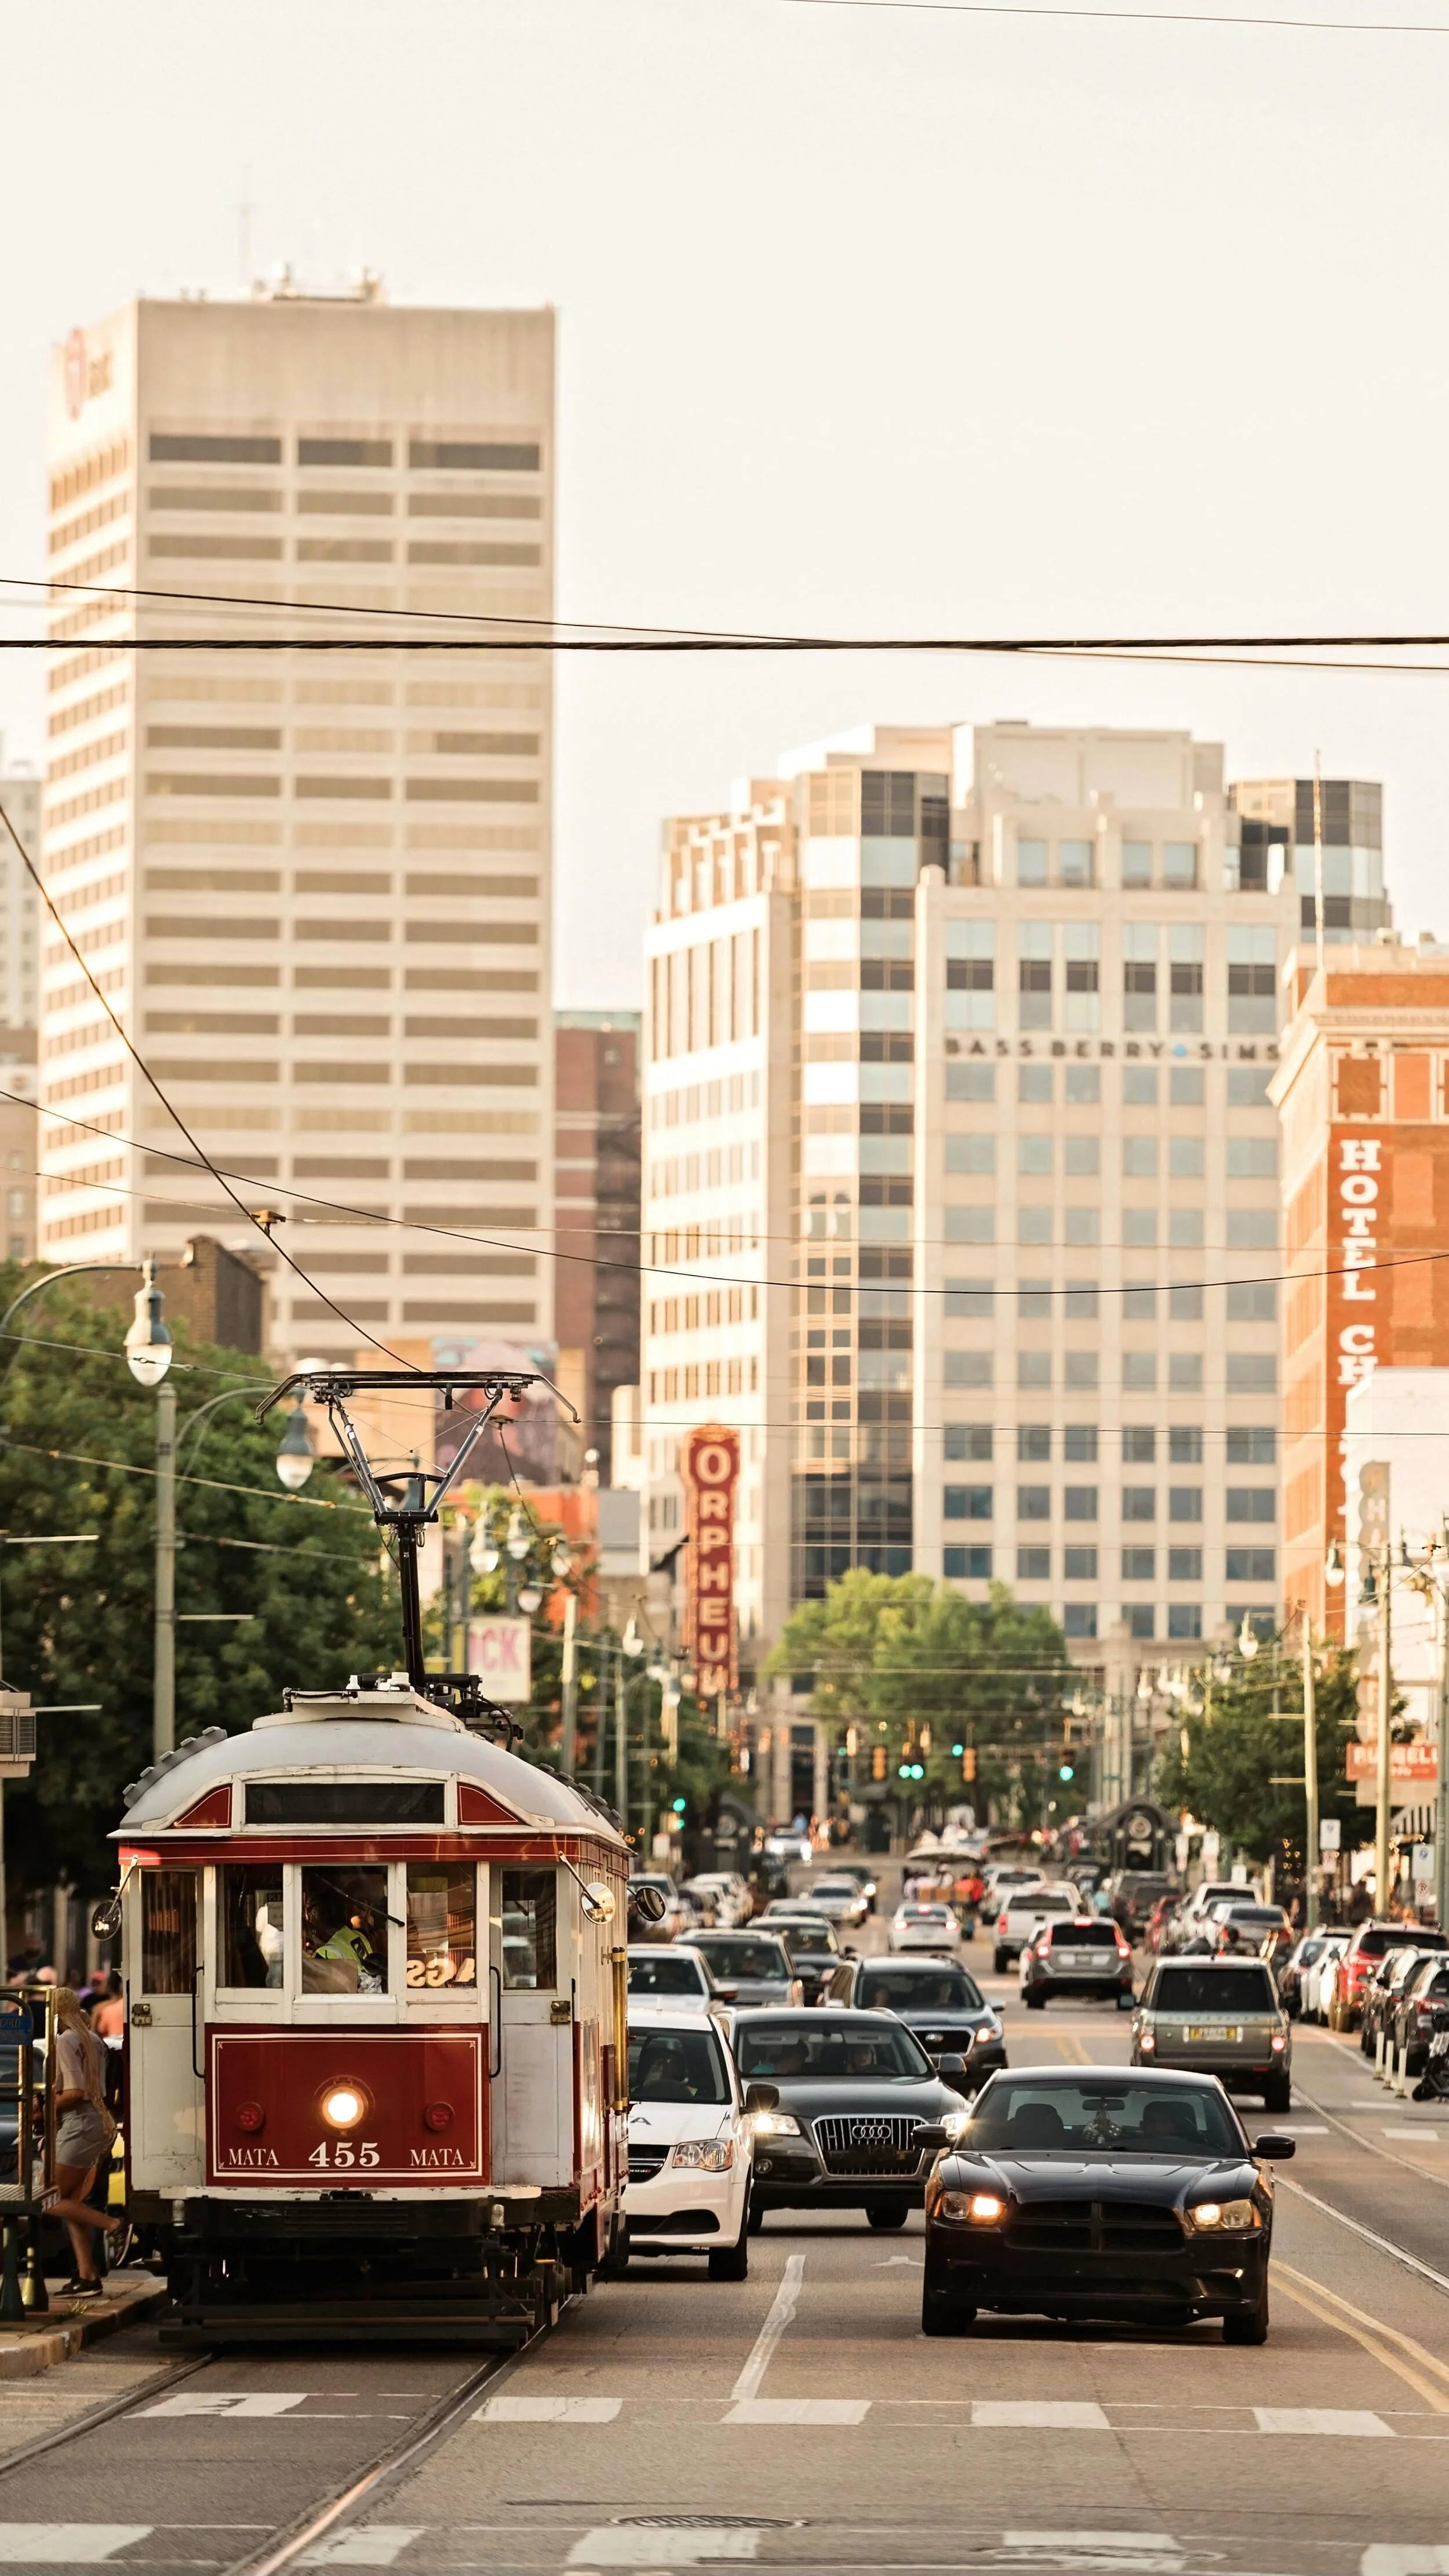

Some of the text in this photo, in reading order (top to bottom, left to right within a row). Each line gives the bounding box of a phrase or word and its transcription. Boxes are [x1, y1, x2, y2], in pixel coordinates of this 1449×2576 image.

[945, 1037, 1281, 1060] BASS BERRY SIMS
[1339, 1139, 1381, 1300] HOTEL
[228, 2141, 465, 2167] MATA 455 MATA
